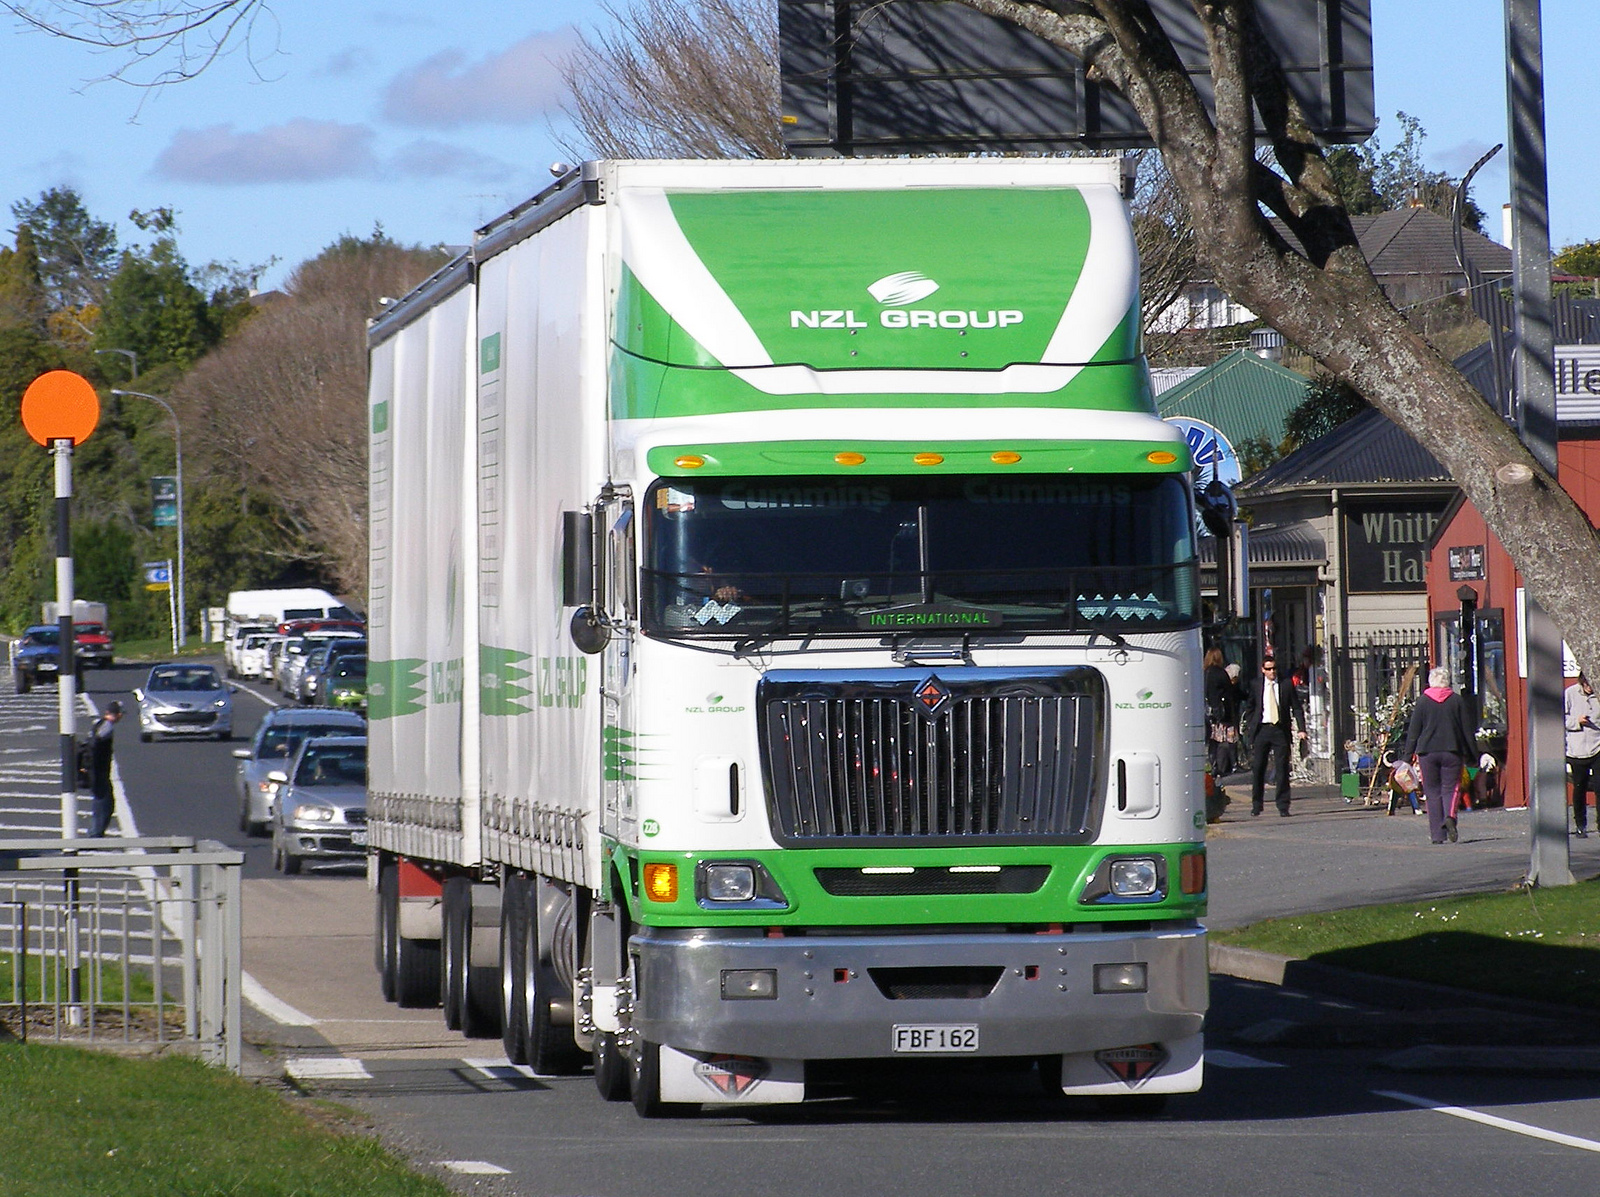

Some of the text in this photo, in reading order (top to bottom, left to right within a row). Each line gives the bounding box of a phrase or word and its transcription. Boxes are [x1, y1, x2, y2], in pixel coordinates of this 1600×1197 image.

[790, 310, 1024, 328] NZL GROUP
[869, 612, 990, 626] INTERNATIONAL
[897, 1029, 975, 1048] FBF162
